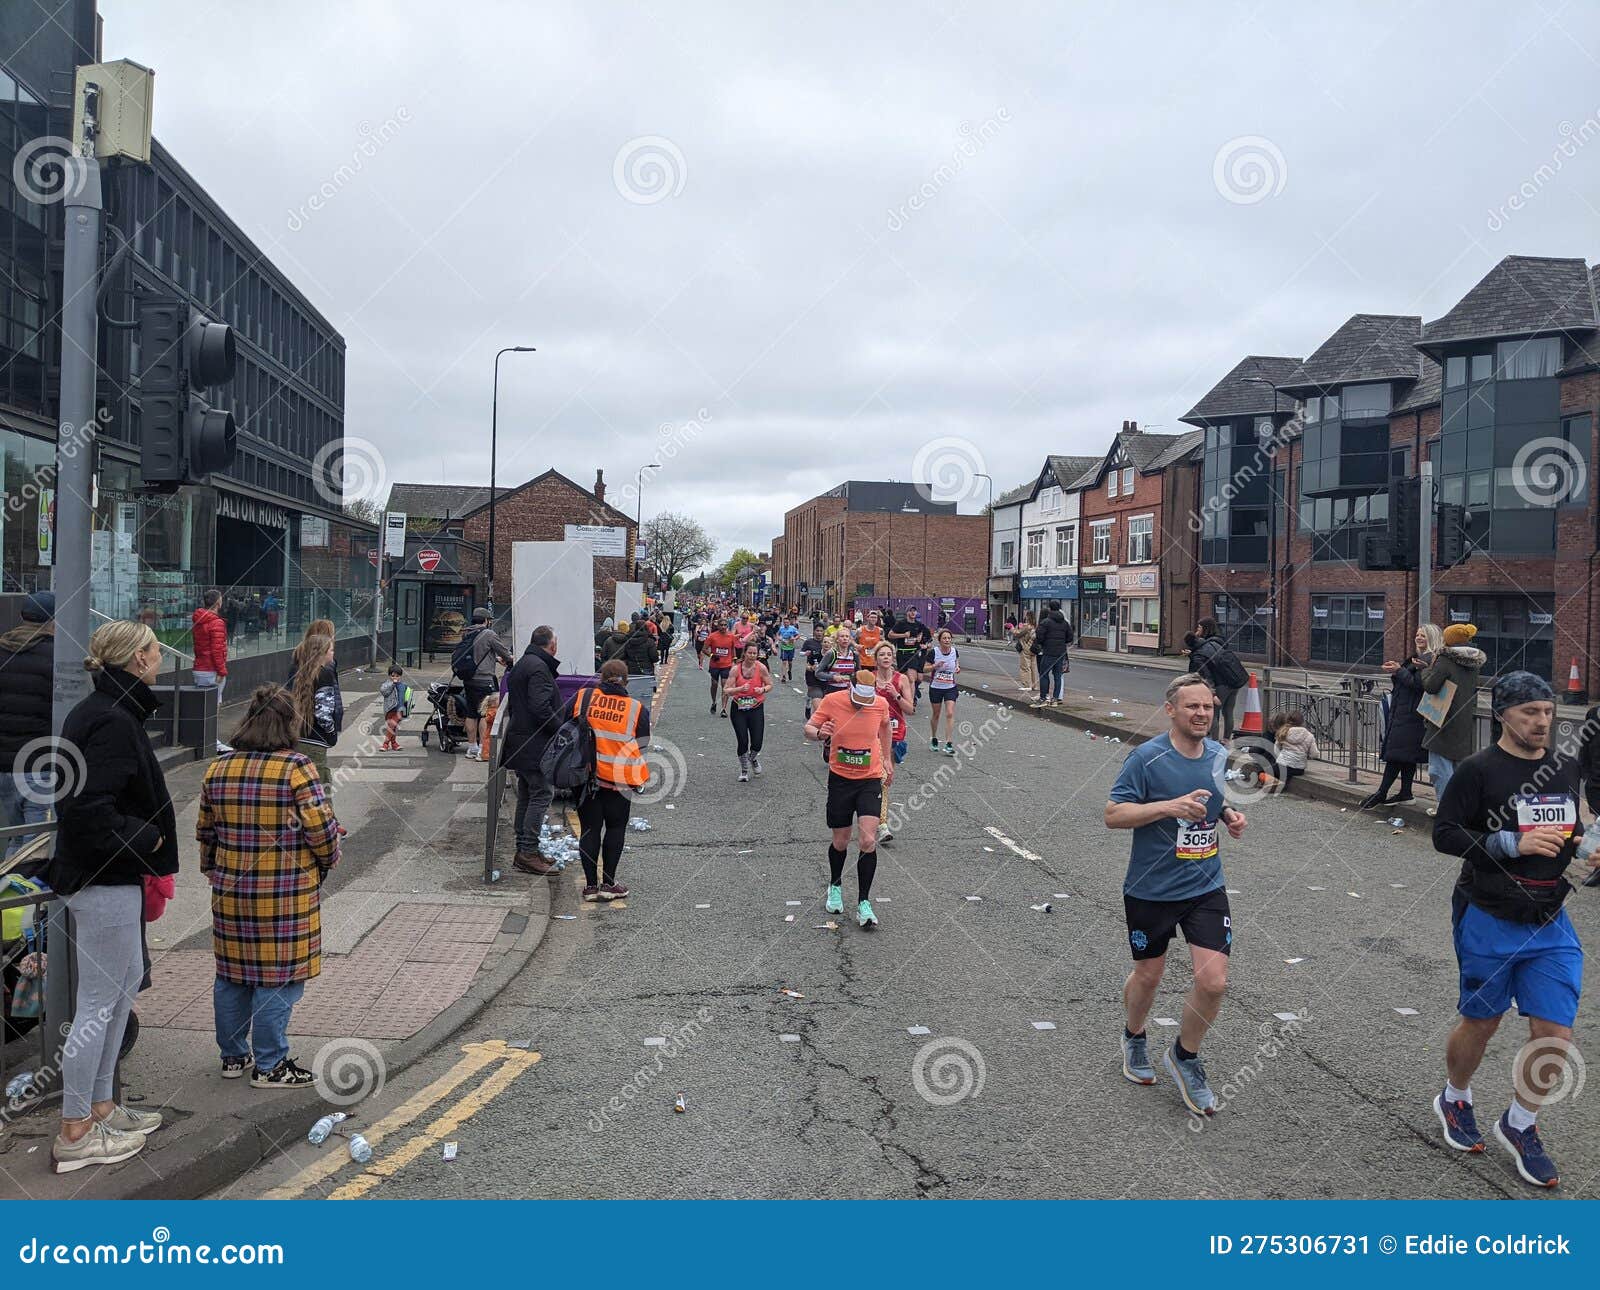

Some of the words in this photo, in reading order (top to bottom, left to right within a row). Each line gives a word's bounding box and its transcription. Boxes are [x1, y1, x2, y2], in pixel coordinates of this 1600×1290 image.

[258, 504, 288, 529] HOUSE
[588, 706, 624, 722] Leader
[845, 755, 863, 764] 3513
[1532, 808, 1565, 822] 31011
